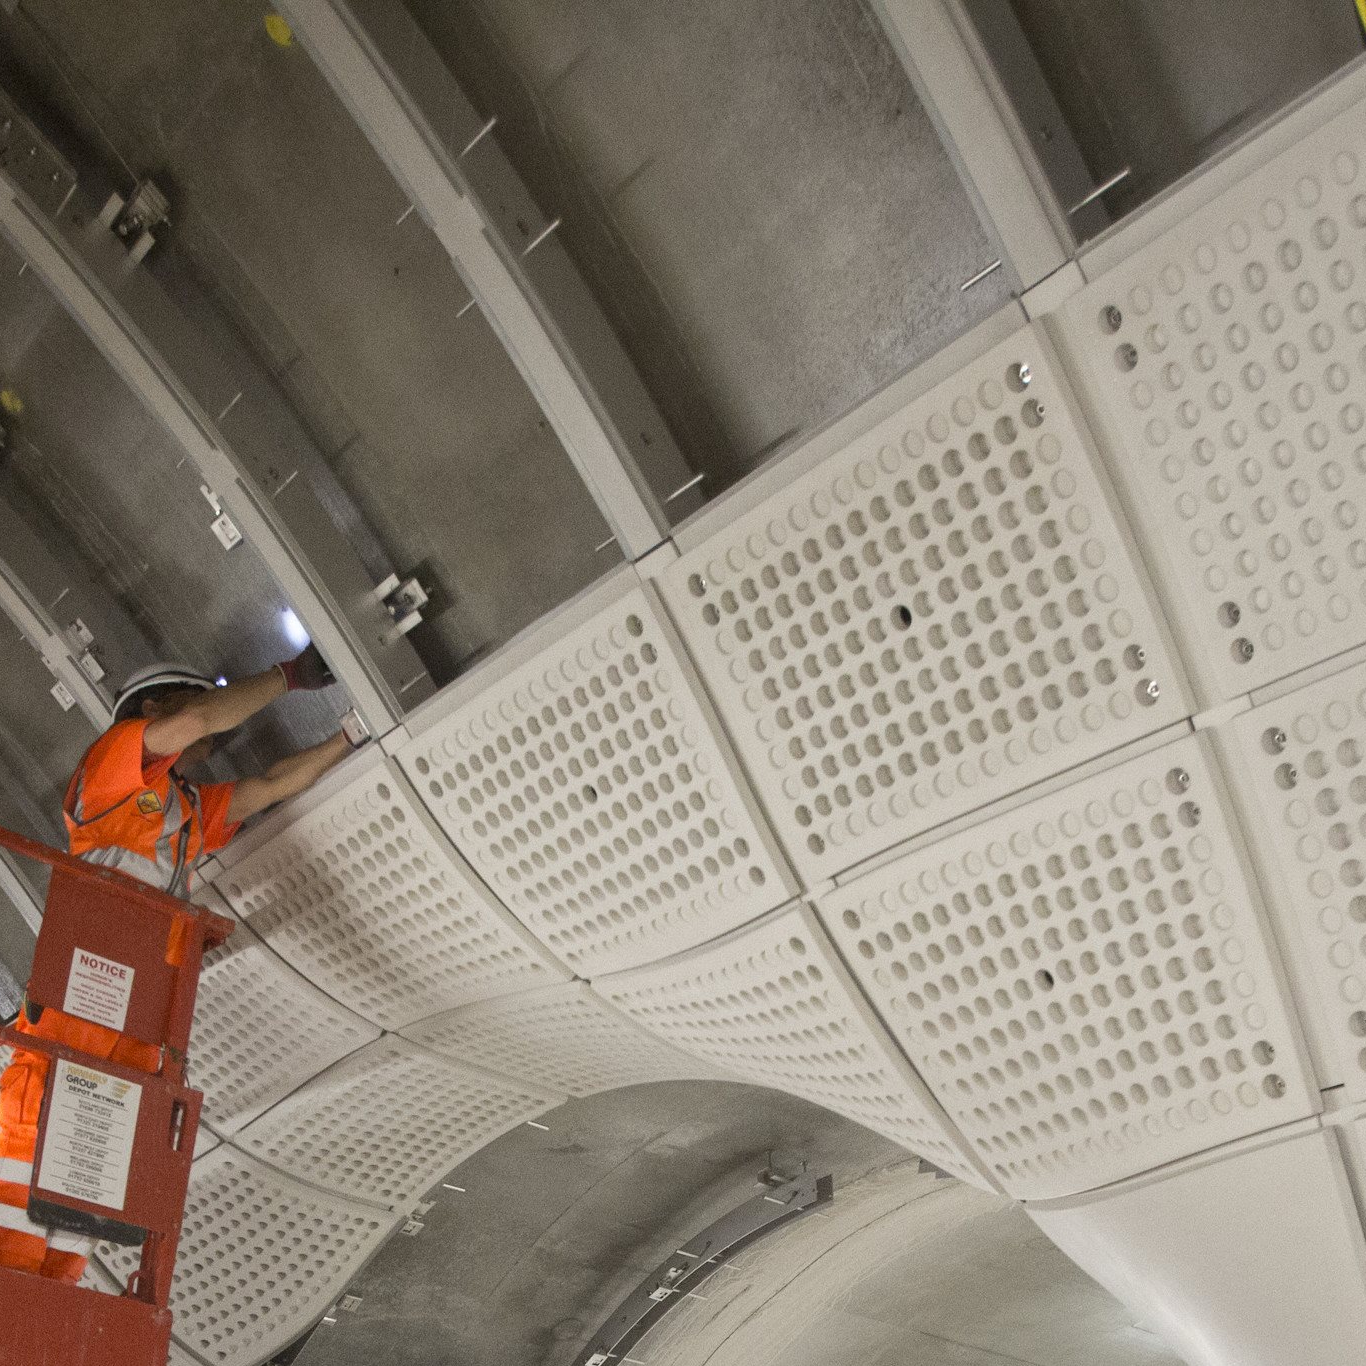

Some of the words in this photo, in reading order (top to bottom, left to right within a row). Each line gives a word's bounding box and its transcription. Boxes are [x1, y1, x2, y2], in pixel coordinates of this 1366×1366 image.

[79, 955, 126, 979] NOTICE
[65, 1074, 97, 1090] GROUP
[68, 1086, 90, 1096] DEPOT
[92, 1093, 124, 1106] NETWORK
